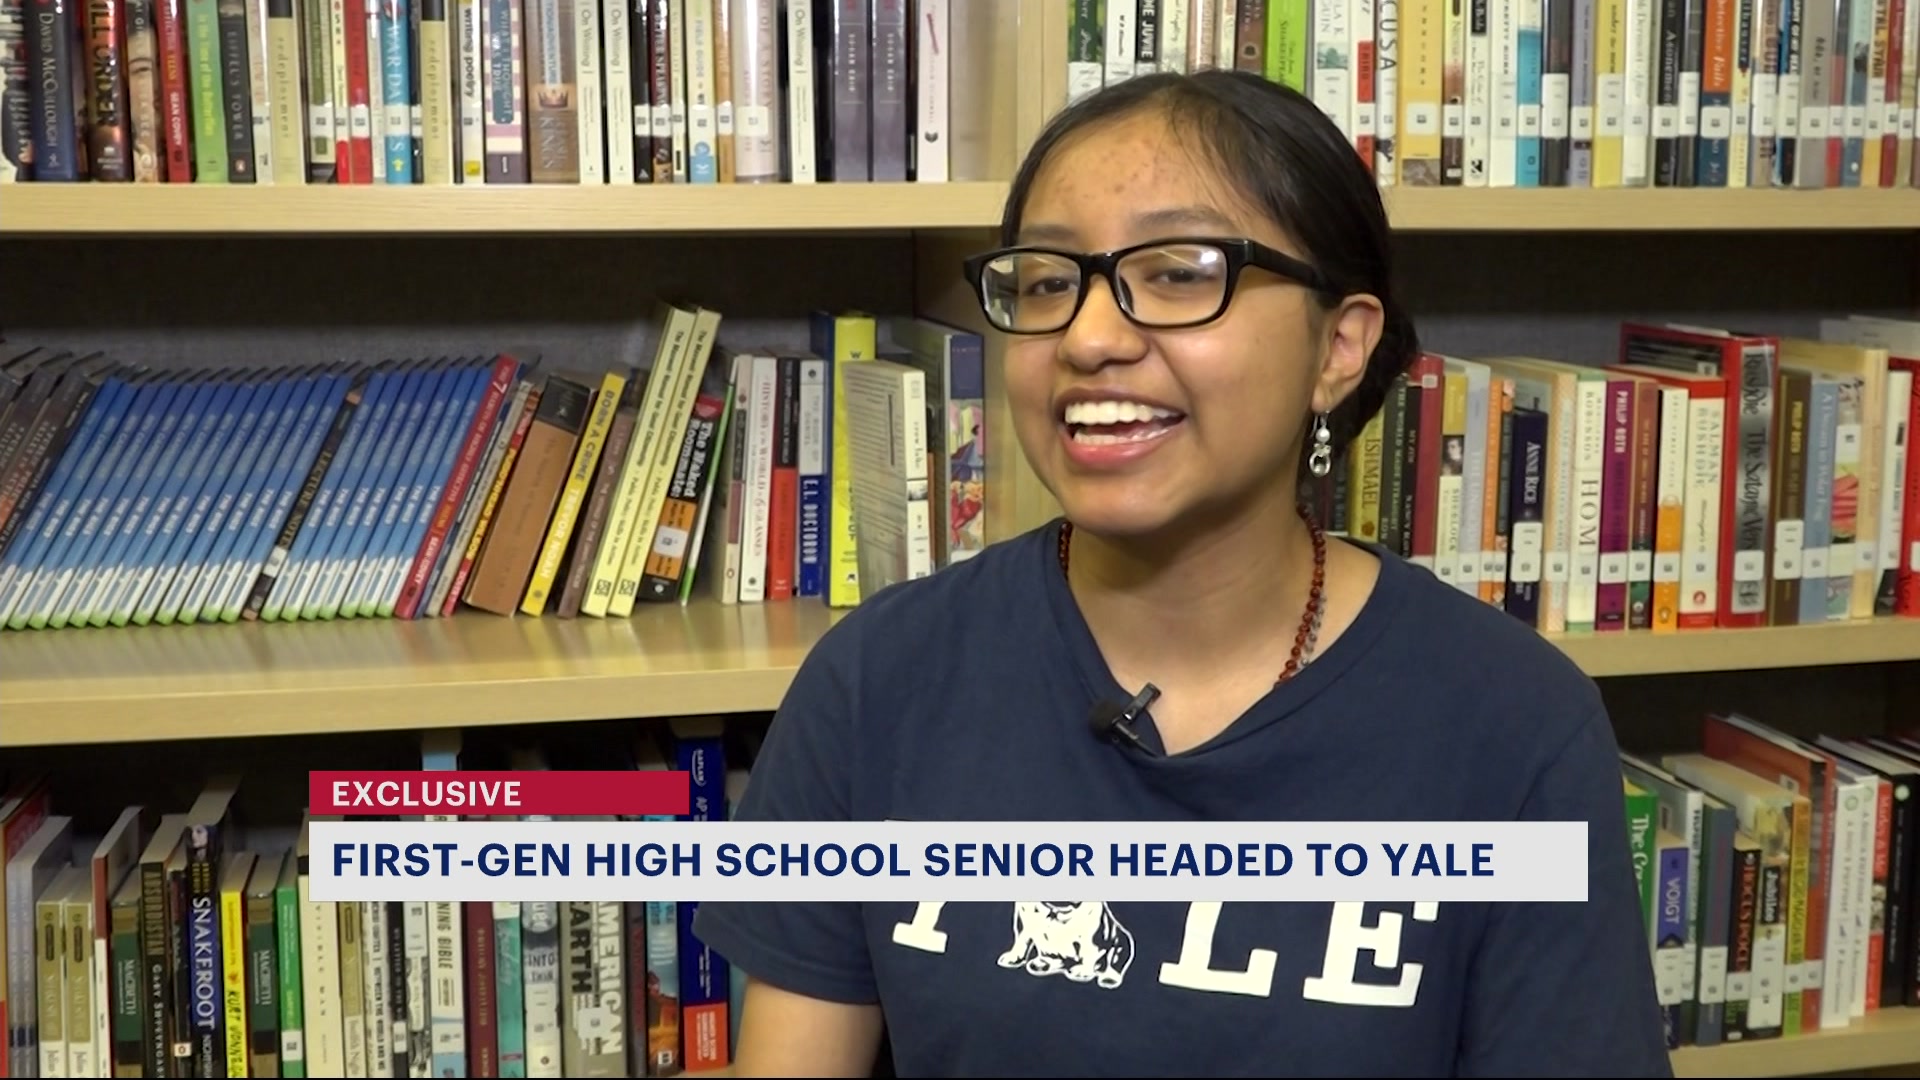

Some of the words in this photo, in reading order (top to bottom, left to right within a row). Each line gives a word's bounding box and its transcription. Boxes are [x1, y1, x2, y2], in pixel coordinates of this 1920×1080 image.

[386, 25, 404, 68] WAR
[463, 8, 477, 54] writing
[1141, 21, 1155, 58] JUVIE
[276, 37, 291, 140] redeployment
[428, 40, 441, 140] redeployment
[465, 57, 478, 98] poetry
[169, 91, 180, 116] SEAN
[172, 116, 183, 147] COVEY
[675, 330, 685, 342] The
[698, 330, 708, 342] The
[493, 382, 508, 394] 7
[1397, 387, 1406, 408] THE
[1742, 352, 1770, 416] Rushdie
[1823, 393, 1833, 403] A
[594, 389, 616, 427] BORN
[760, 381, 772, 429] HISTORY
[1615, 390, 1629, 425] PHILIP
[1791, 401, 1804, 430] PHILIP
[477, 421, 489, 433] OF
[696, 420, 715, 449] The
[1395, 411, 1405, 447] WORLD
[1584, 390, 1595, 463] ROBINSON
[1614, 427, 1628, 454] ROTH
[1746, 427, 1768, 458] The
[1790, 430, 1803, 453] ROTH
[1820, 406, 1833, 448] Dream
[465, 433, 483, 462] HIGHLY
[574, 441, 598, 483] CRIME
[669, 418, 702, 499] Roommate:
[1393, 449, 1402, 479] MADE
[1524, 441, 1541, 475] ANNE
[1694, 407, 1710, 489] RUSHDIE
[1709, 410, 1722, 484] SALMAN
[301, 450, 333, 506] LECTURE
[683, 449, 707, 498] Naked
[757, 447, 769, 489] WORLD
[1361, 438, 1382, 510] ISHMAEL
[1816, 465, 1830, 495] Polar
[802, 479, 819, 501] E.L.
[1390, 481, 1401, 531] STRAIGHT
[1523, 476, 1540, 504] RICE
[1739, 460, 1768, 515] Satanic
[281, 514, 304, 549] NOTES
[554, 488, 580, 539] TREVOR
[1381, 517, 1389, 541] RON
[1448, 487, 1460, 552] SHERLOCK
[1580, 479, 1599, 547] HOM
[427, 537, 441, 557] SEAN
[465, 518, 490, 560] WILSON
[802, 503, 819, 564] DOCTOROW
[1741, 516, 1764, 551] Vers
[413, 558, 432, 585] COVEY
[539, 540, 562, 578] NOAH
[1631, 813, 1650, 850] The
[1875, 795, 1890, 838] Marley
[1856, 857, 1867, 905] PURPOSE
[1873, 854, 1887, 874] Me
[1663, 876, 1683, 925] VOIGT
[1738, 863, 1758, 921] HOCUS
[1763, 868, 1780, 923] Jubilee
[1840, 866, 1852, 915] PURPOSE
[143, 871, 165, 956] ABSURDISTAN
[190, 896, 216, 1030] SNAKEROOT
[438, 936, 453, 969] BIBLE
[569, 901, 592, 994] ARTH
[123, 958, 137, 1016] MACBETH
[152, 964, 163, 998] GARY
[258, 949, 273, 1006] MACBETH
[373, 966, 382, 1002] BETWEEN
[597, 901, 623, 1056] MERICAN
[226, 989, 242, 1022] KURT
[375, 1003, 384, 1017] THE
[377, 1019, 386, 1043] WORLD
[378, 1045, 387, 1059] AND
[378, 1060, 387, 1071] ME
